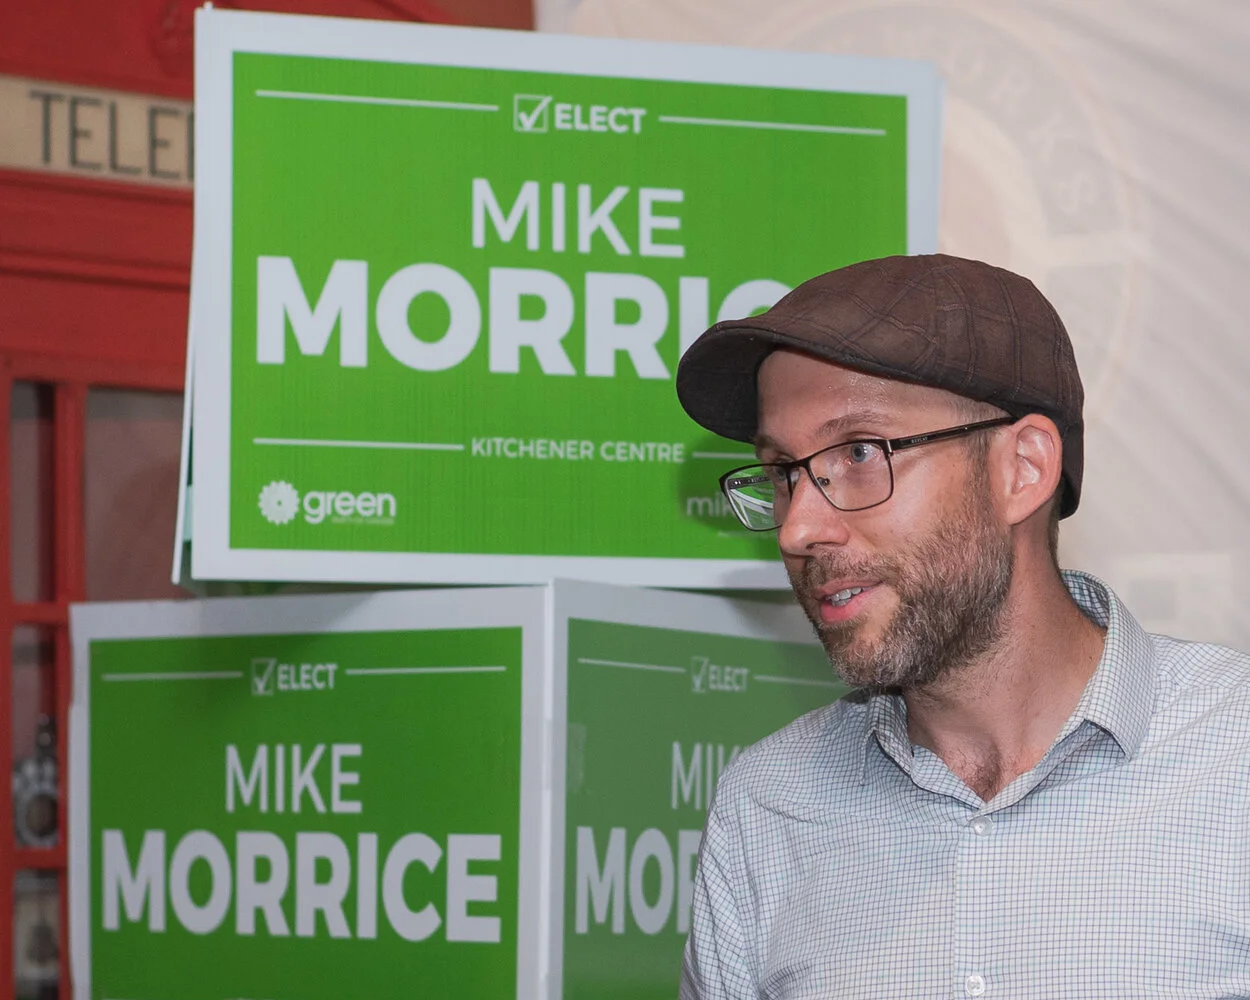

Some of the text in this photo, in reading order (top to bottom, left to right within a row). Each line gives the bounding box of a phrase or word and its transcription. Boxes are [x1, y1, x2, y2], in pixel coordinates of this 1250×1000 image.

[554, 103, 647, 134] ELECT
[471, 178, 686, 258] MIKE
[472, 437, 685, 463] KITCHENER CENTRE
[303, 491, 397, 524] green
[277, 663, 339, 691] ELECT
[708, 664, 749, 692] ELECT
[225, 743, 363, 814] MIKE
[102, 829, 502, 943] MORRICE
